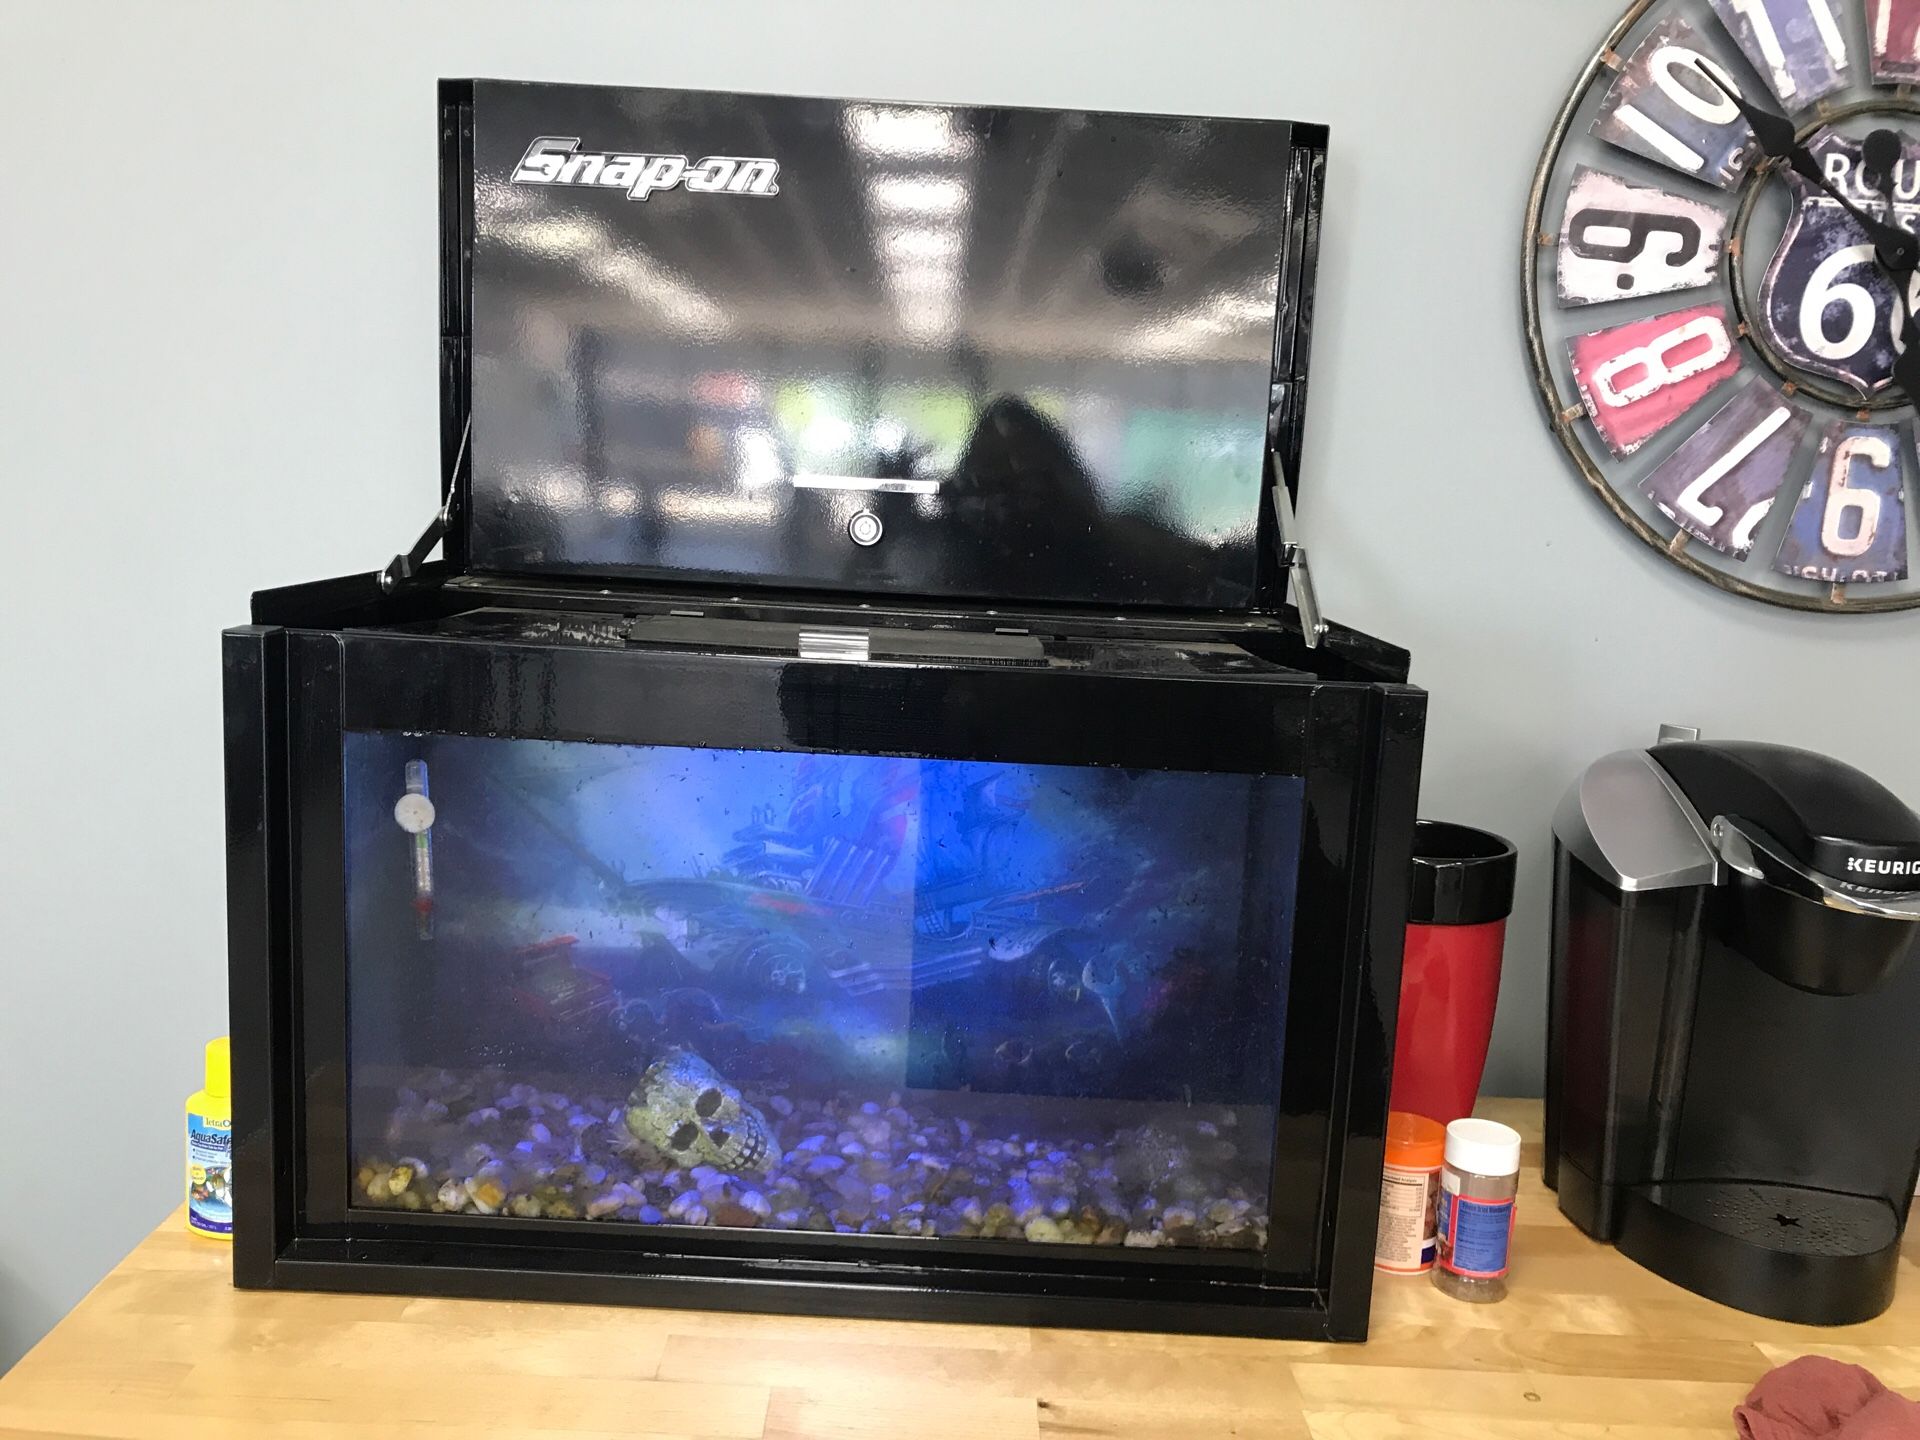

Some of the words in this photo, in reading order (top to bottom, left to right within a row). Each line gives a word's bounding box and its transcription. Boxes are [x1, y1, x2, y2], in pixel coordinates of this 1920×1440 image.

[511, 136, 779, 201] Snap-on
[1613, 45, 1742, 173] 10
[1592, 316, 1732, 408] 8
[1677, 406, 1791, 527] 7
[1821, 436, 1890, 557] 6
